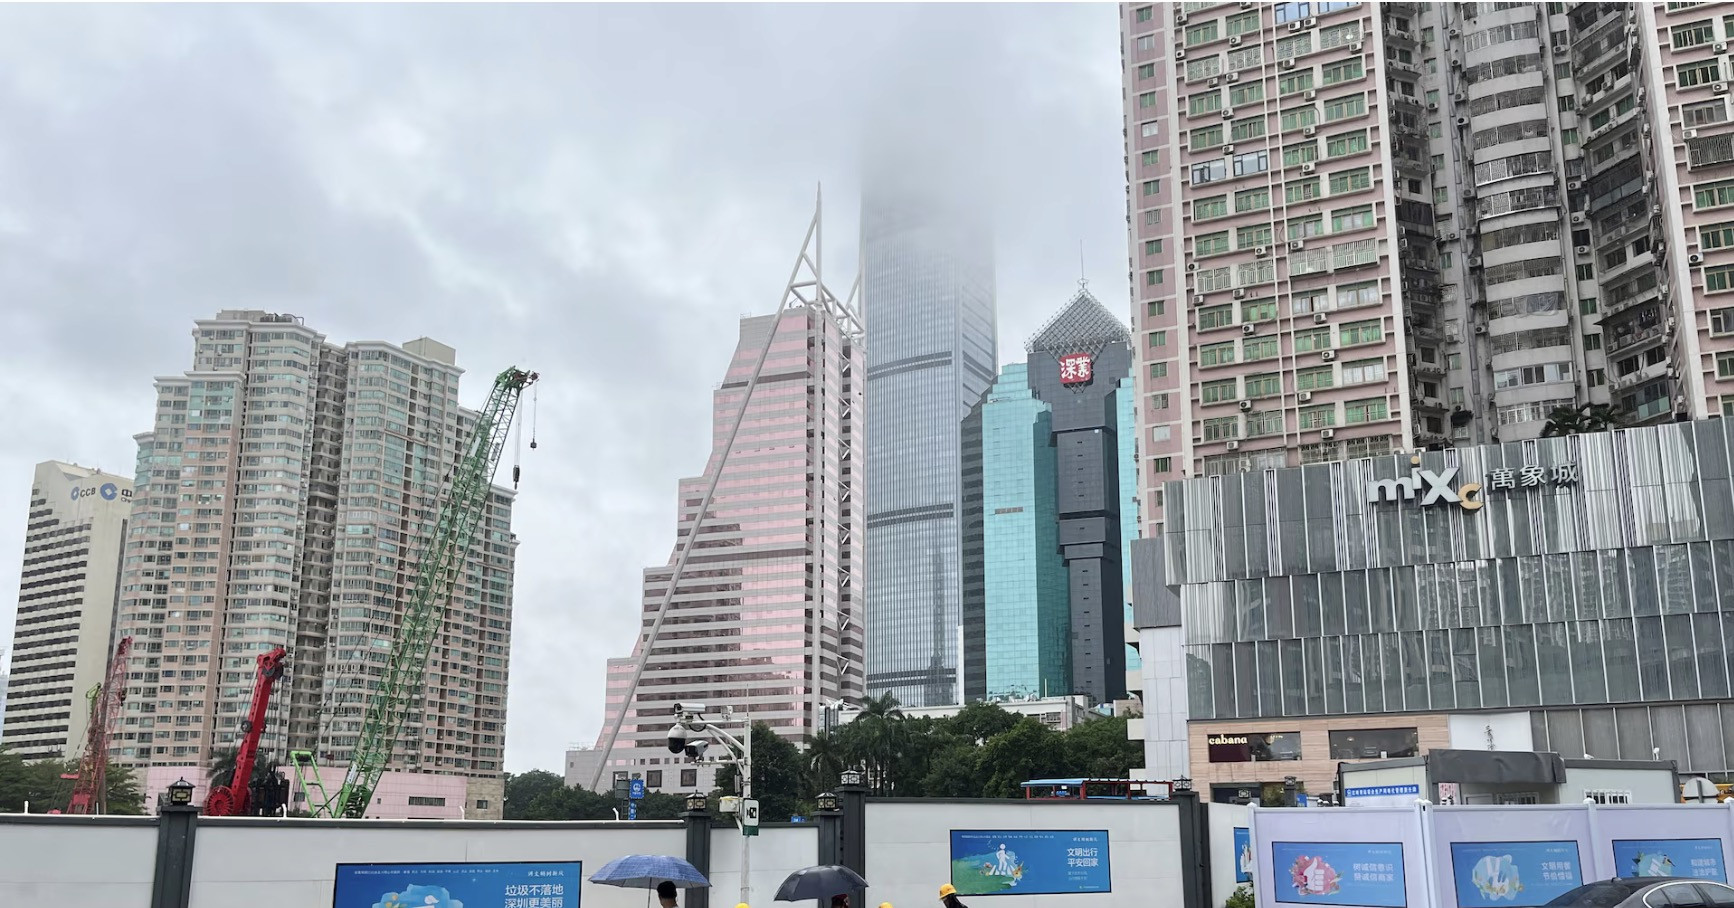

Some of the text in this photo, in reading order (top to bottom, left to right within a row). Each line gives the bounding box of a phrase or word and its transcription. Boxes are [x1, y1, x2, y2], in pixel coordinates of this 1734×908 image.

[1491, 460, 1579, 491] 萬象城
[80, 487, 96, 498] CCB
[1208, 734, 1248, 745] cabana
[1067, 847, 1098, 857] 文明出行
[1067, 857, 1099, 867] 平安回家
[504, 883, 564, 896] 垃圾不落地
[504, 896, 563, 908] 深圳更美丽
